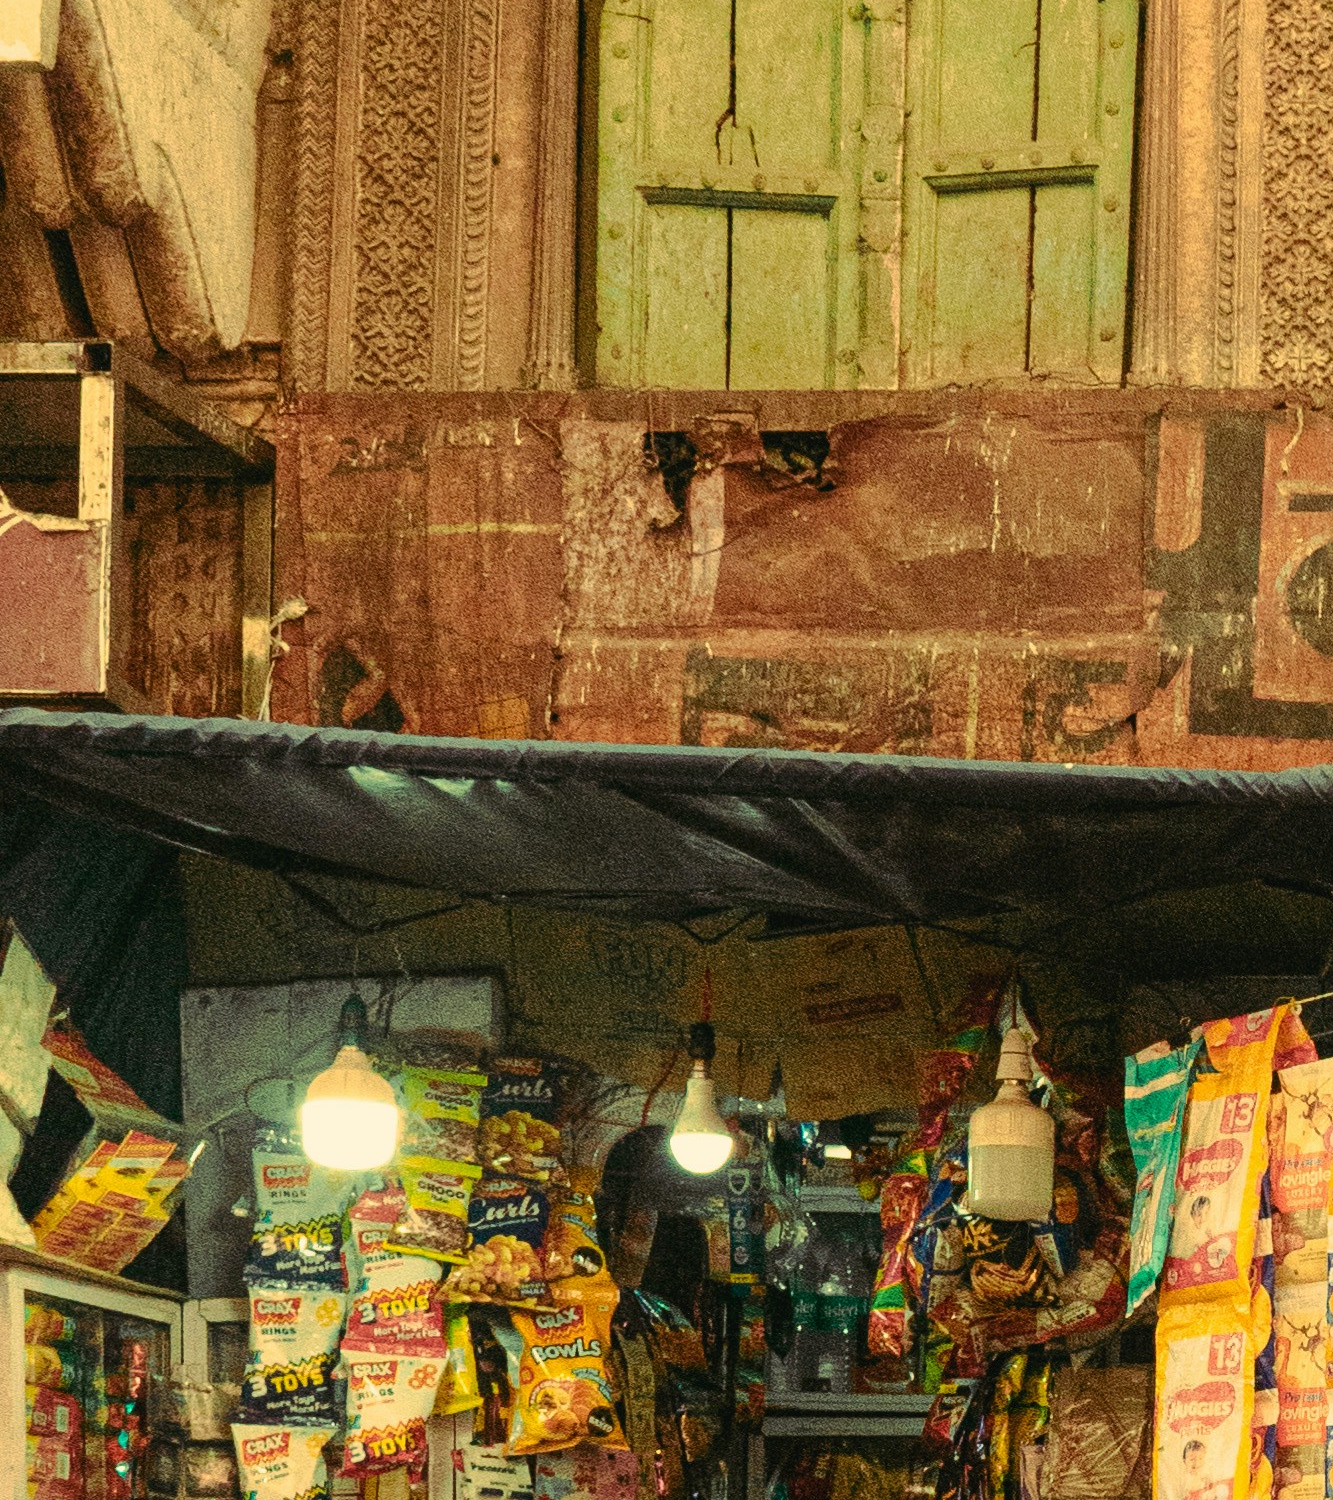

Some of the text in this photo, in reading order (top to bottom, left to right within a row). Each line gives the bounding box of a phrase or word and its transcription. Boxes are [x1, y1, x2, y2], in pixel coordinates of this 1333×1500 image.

[1227, 1097, 1254, 1132] 13
[260, 1234, 278, 1257] 3
[256, 1299, 295, 1315] CRAX
[358, 1293, 430, 1324] 3 TOYS
[536, 1307, 581, 1330] CRAX
[1213, 1334, 1242, 1376] 13
[353, 1362, 391, 1378] CRAX
[251, 1369, 325, 1398] 3 TOYS
[1169, 1399, 1234, 1419] HUGGIES
[246, 1434, 286, 1455] CRAX
[349, 1434, 416, 1463] 3 TOYS
